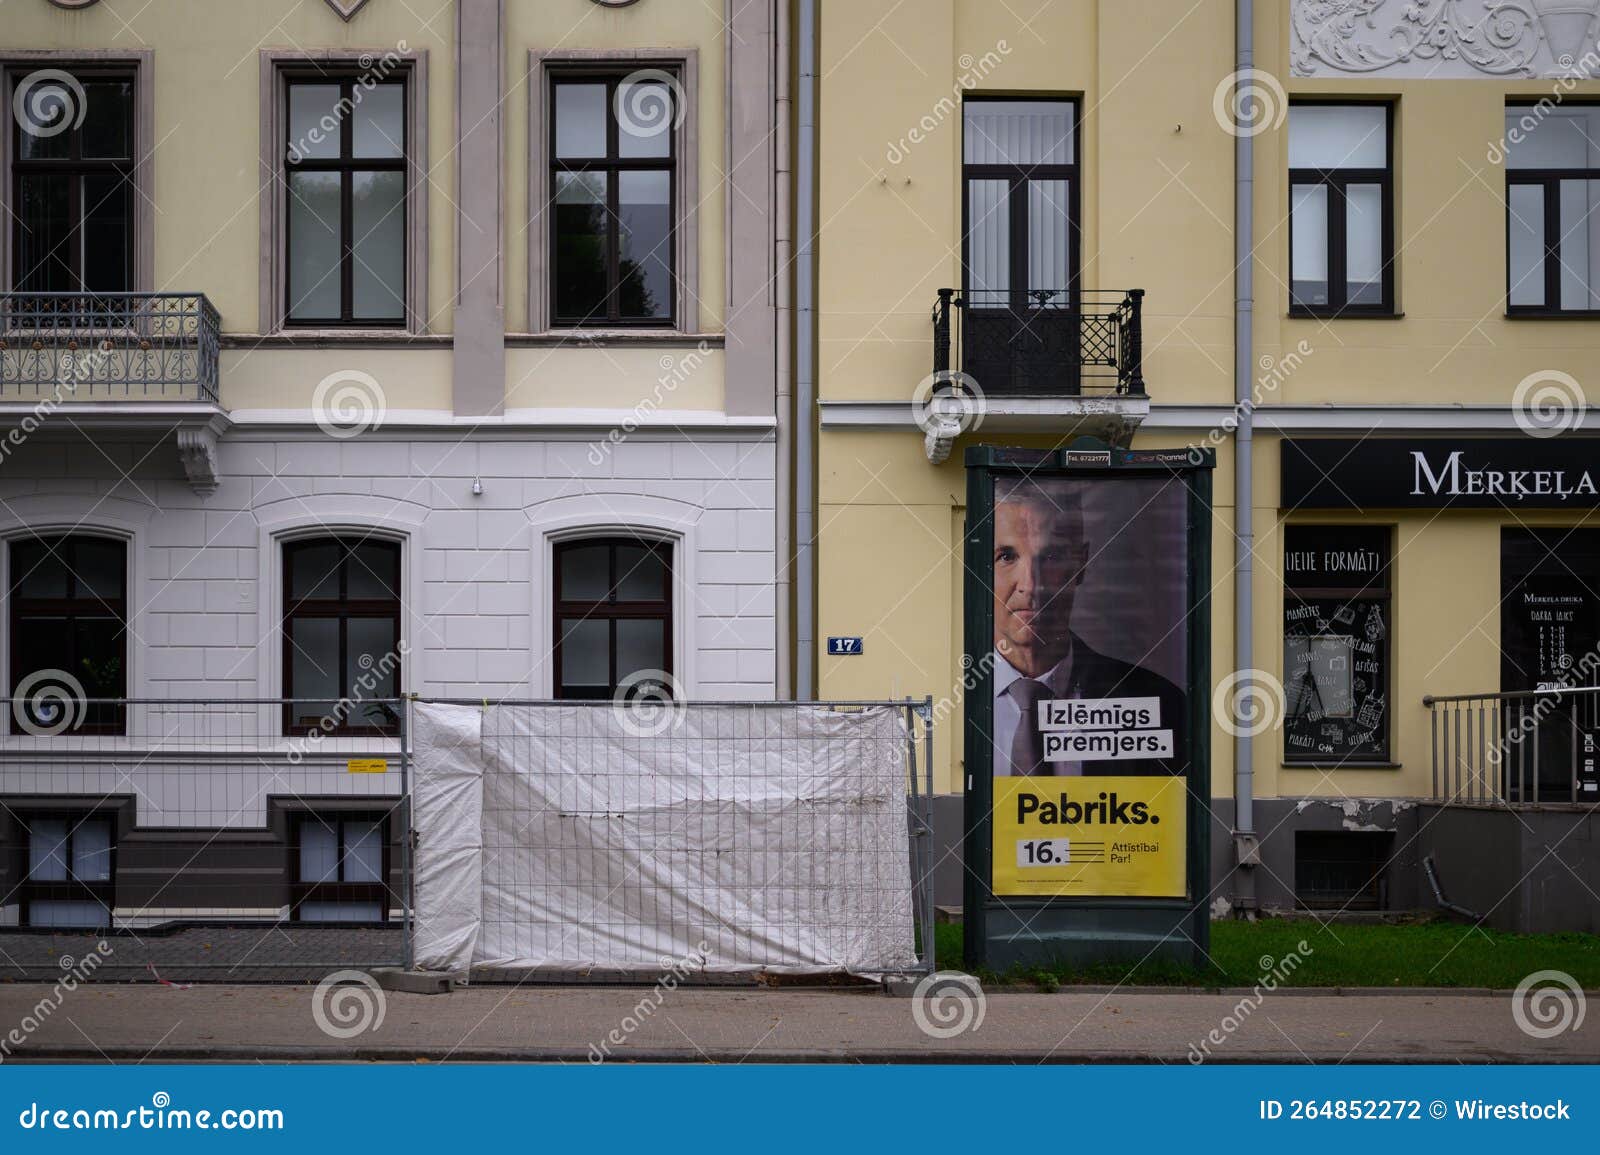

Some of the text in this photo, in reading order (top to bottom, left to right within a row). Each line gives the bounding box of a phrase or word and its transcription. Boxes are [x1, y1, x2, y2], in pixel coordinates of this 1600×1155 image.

[1410, 451, 1598, 500] MERĶEĻA
[1324, 548, 1379, 572] FORMĀTI
[835, 639, 855, 652] 17
[1355, 659, 1379, 673] AFIŠAS
[1046, 703, 1150, 728] Izlēmīgs
[1046, 730, 1167, 757] premjers.
[1017, 792, 1160, 825] Pabriks.
[1024, 841, 1061, 863] 16.
[1111, 853, 1131, 864] Par!
